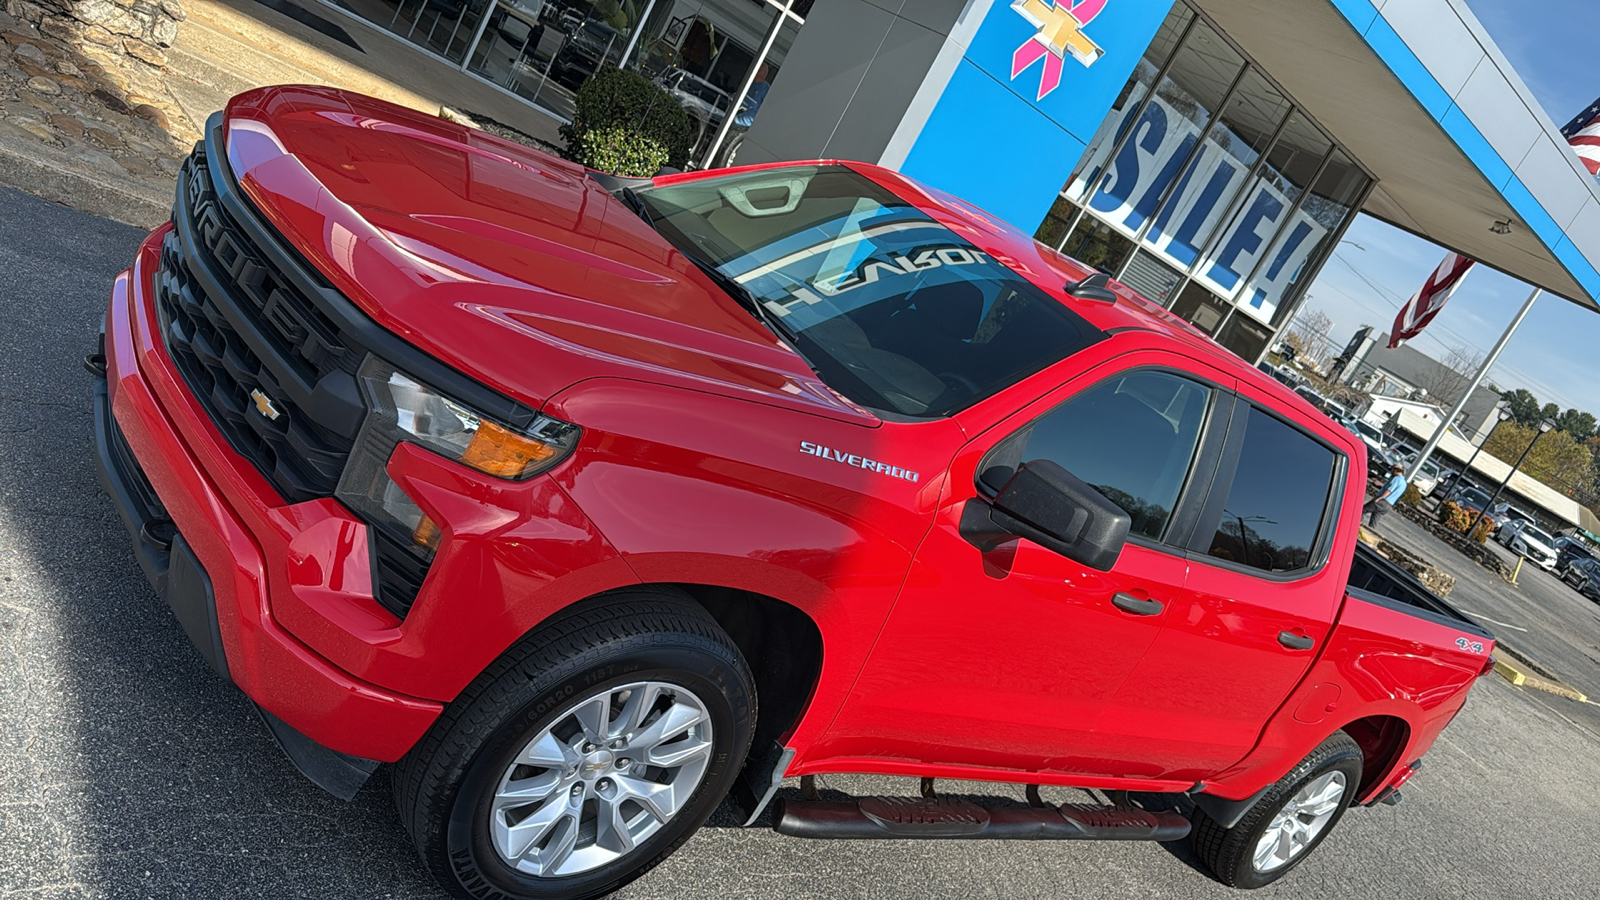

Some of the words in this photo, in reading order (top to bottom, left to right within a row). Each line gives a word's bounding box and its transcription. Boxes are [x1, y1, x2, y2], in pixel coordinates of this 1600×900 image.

[187, 141, 346, 360] HEVROLET
[1084, 100, 1312, 309] SALE!
[799, 440, 919, 482] SILVERADO
